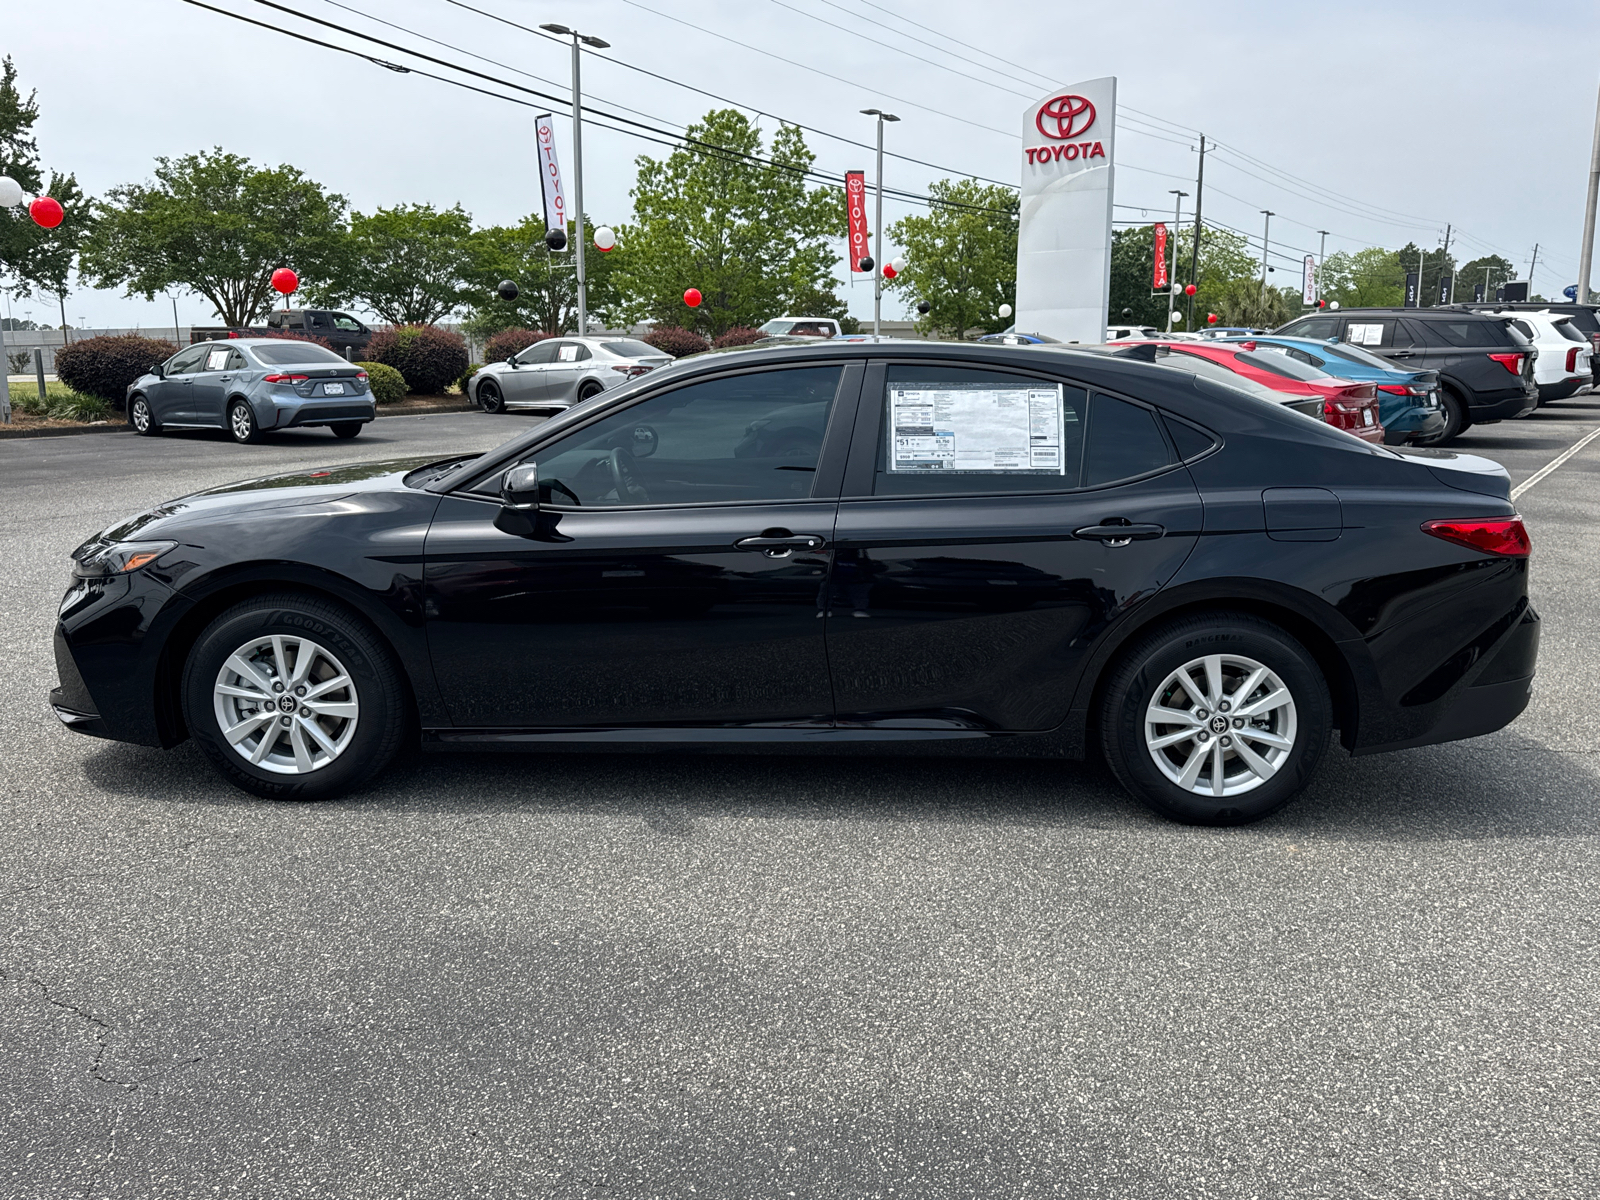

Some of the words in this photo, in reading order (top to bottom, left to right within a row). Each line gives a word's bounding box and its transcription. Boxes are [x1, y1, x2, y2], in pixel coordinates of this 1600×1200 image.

[1025, 141, 1105, 165] TOYOTA
[544, 147, 564, 235] TOYOT
[283, 614, 364, 666] GOODYEAR
[1185, 634, 1243, 649] RANGEMAX
